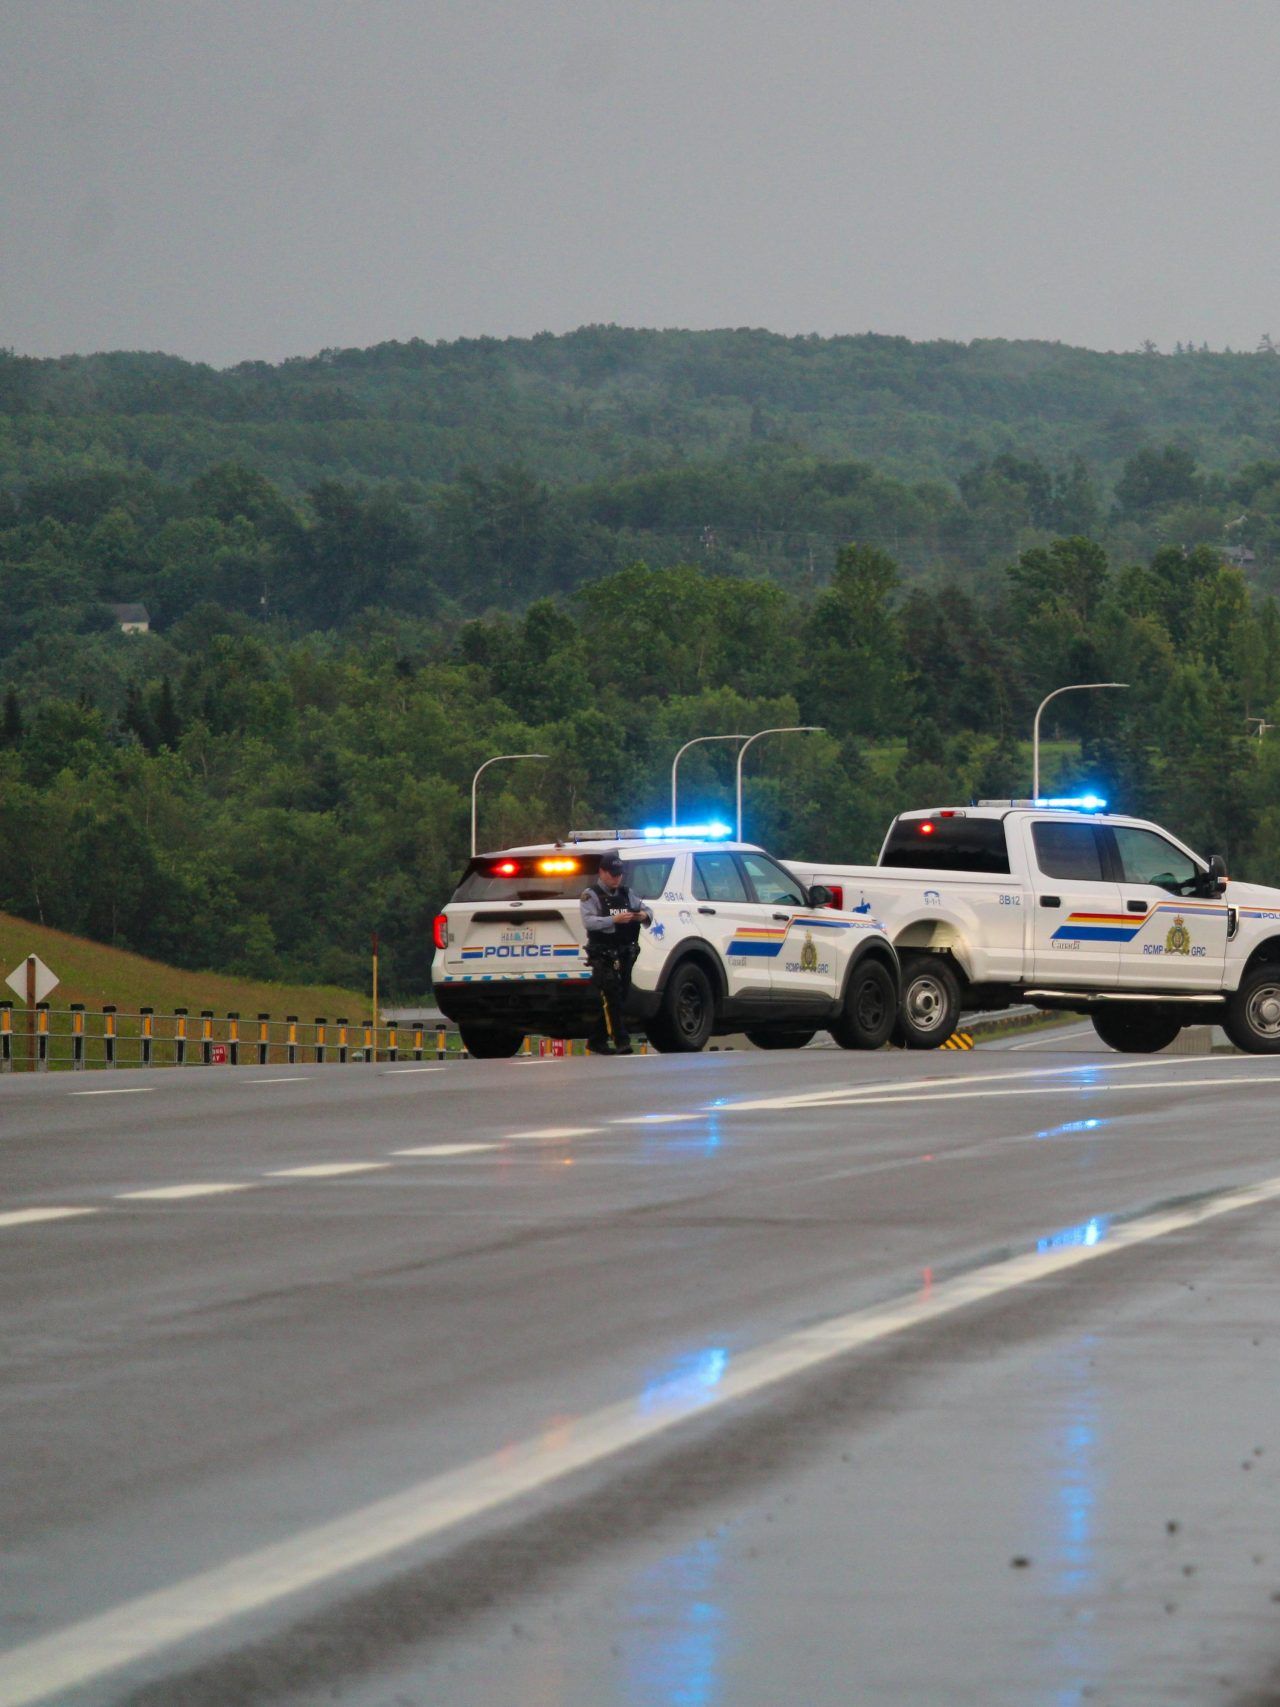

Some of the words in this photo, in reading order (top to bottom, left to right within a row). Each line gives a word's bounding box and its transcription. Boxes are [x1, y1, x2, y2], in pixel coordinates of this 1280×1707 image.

[484, 944, 552, 958] POLICE
[1051, 940, 1081, 950] Canada
[1143, 944, 1164, 955] RCMP
[1191, 946, 1206, 957] GRC
